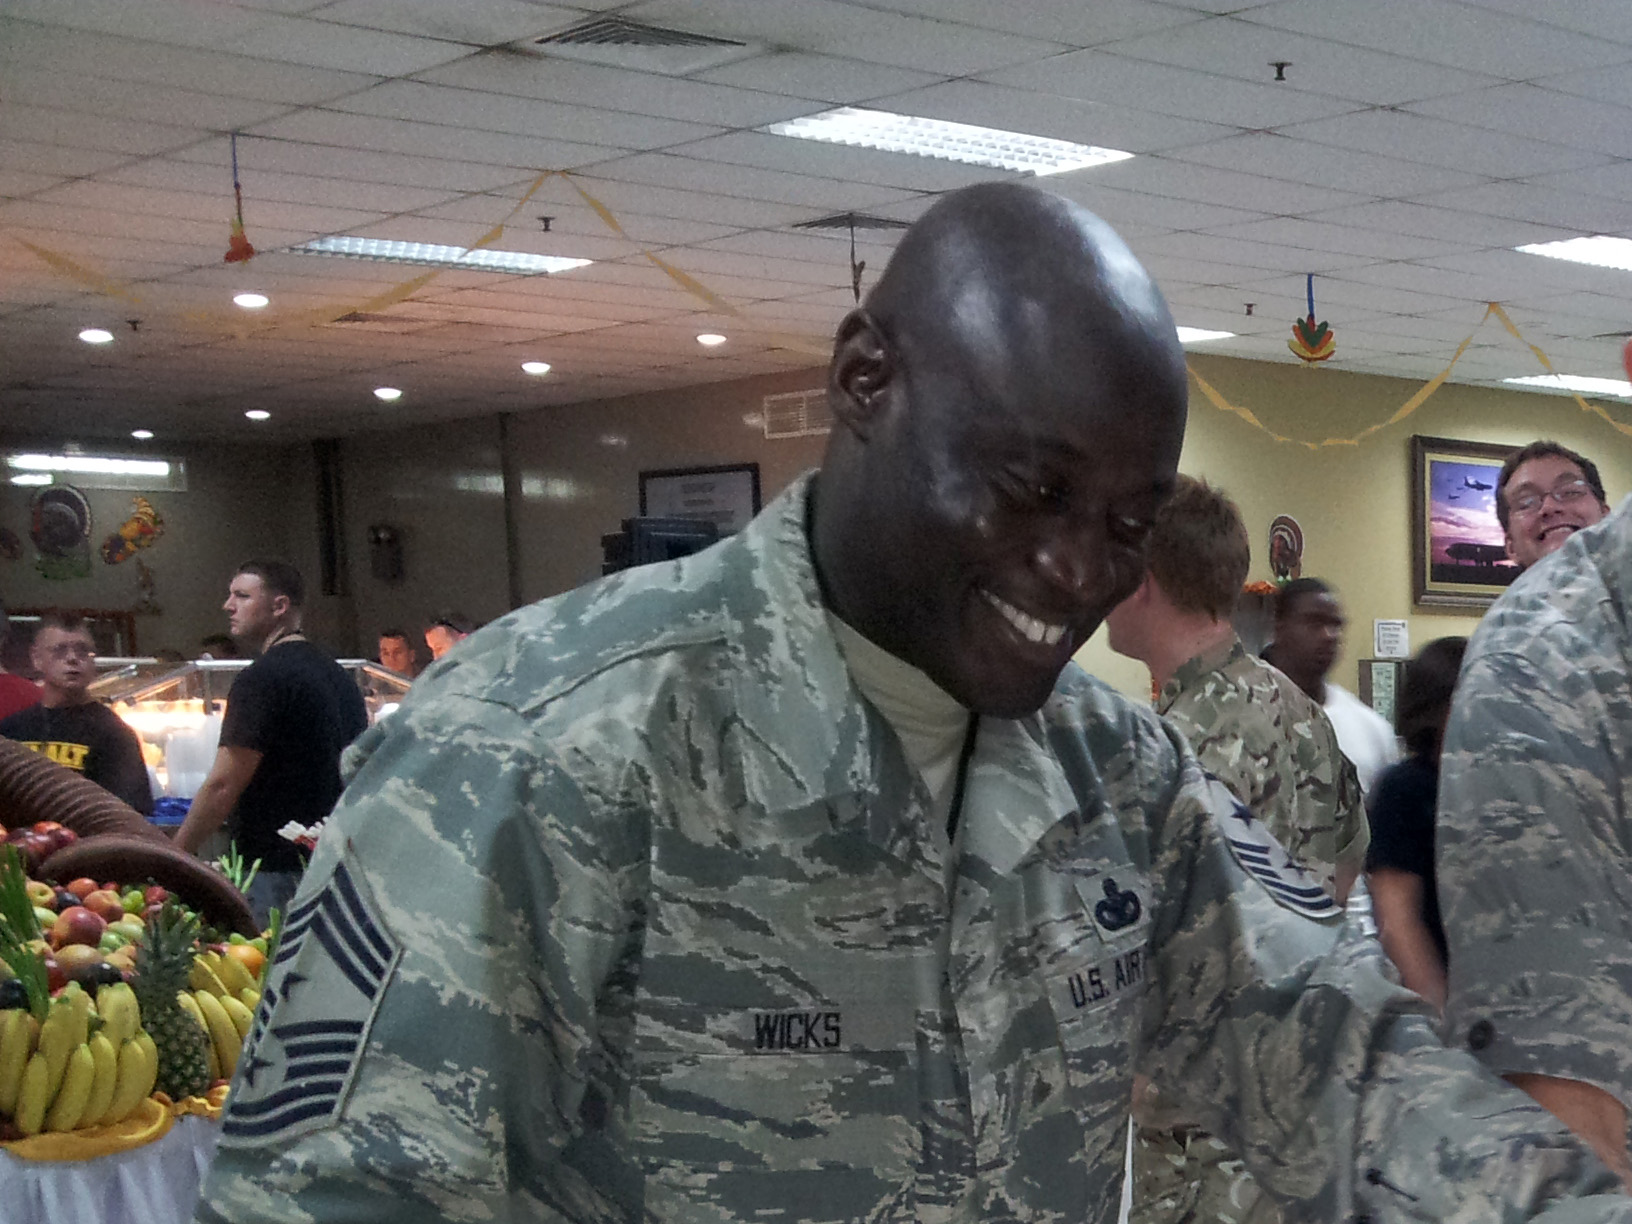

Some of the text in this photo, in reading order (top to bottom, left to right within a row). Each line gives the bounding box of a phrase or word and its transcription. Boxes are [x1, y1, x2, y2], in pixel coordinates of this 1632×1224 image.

[1067, 949, 1141, 1008] U.S. AIR
[754, 1012, 841, 1050] WICKS
